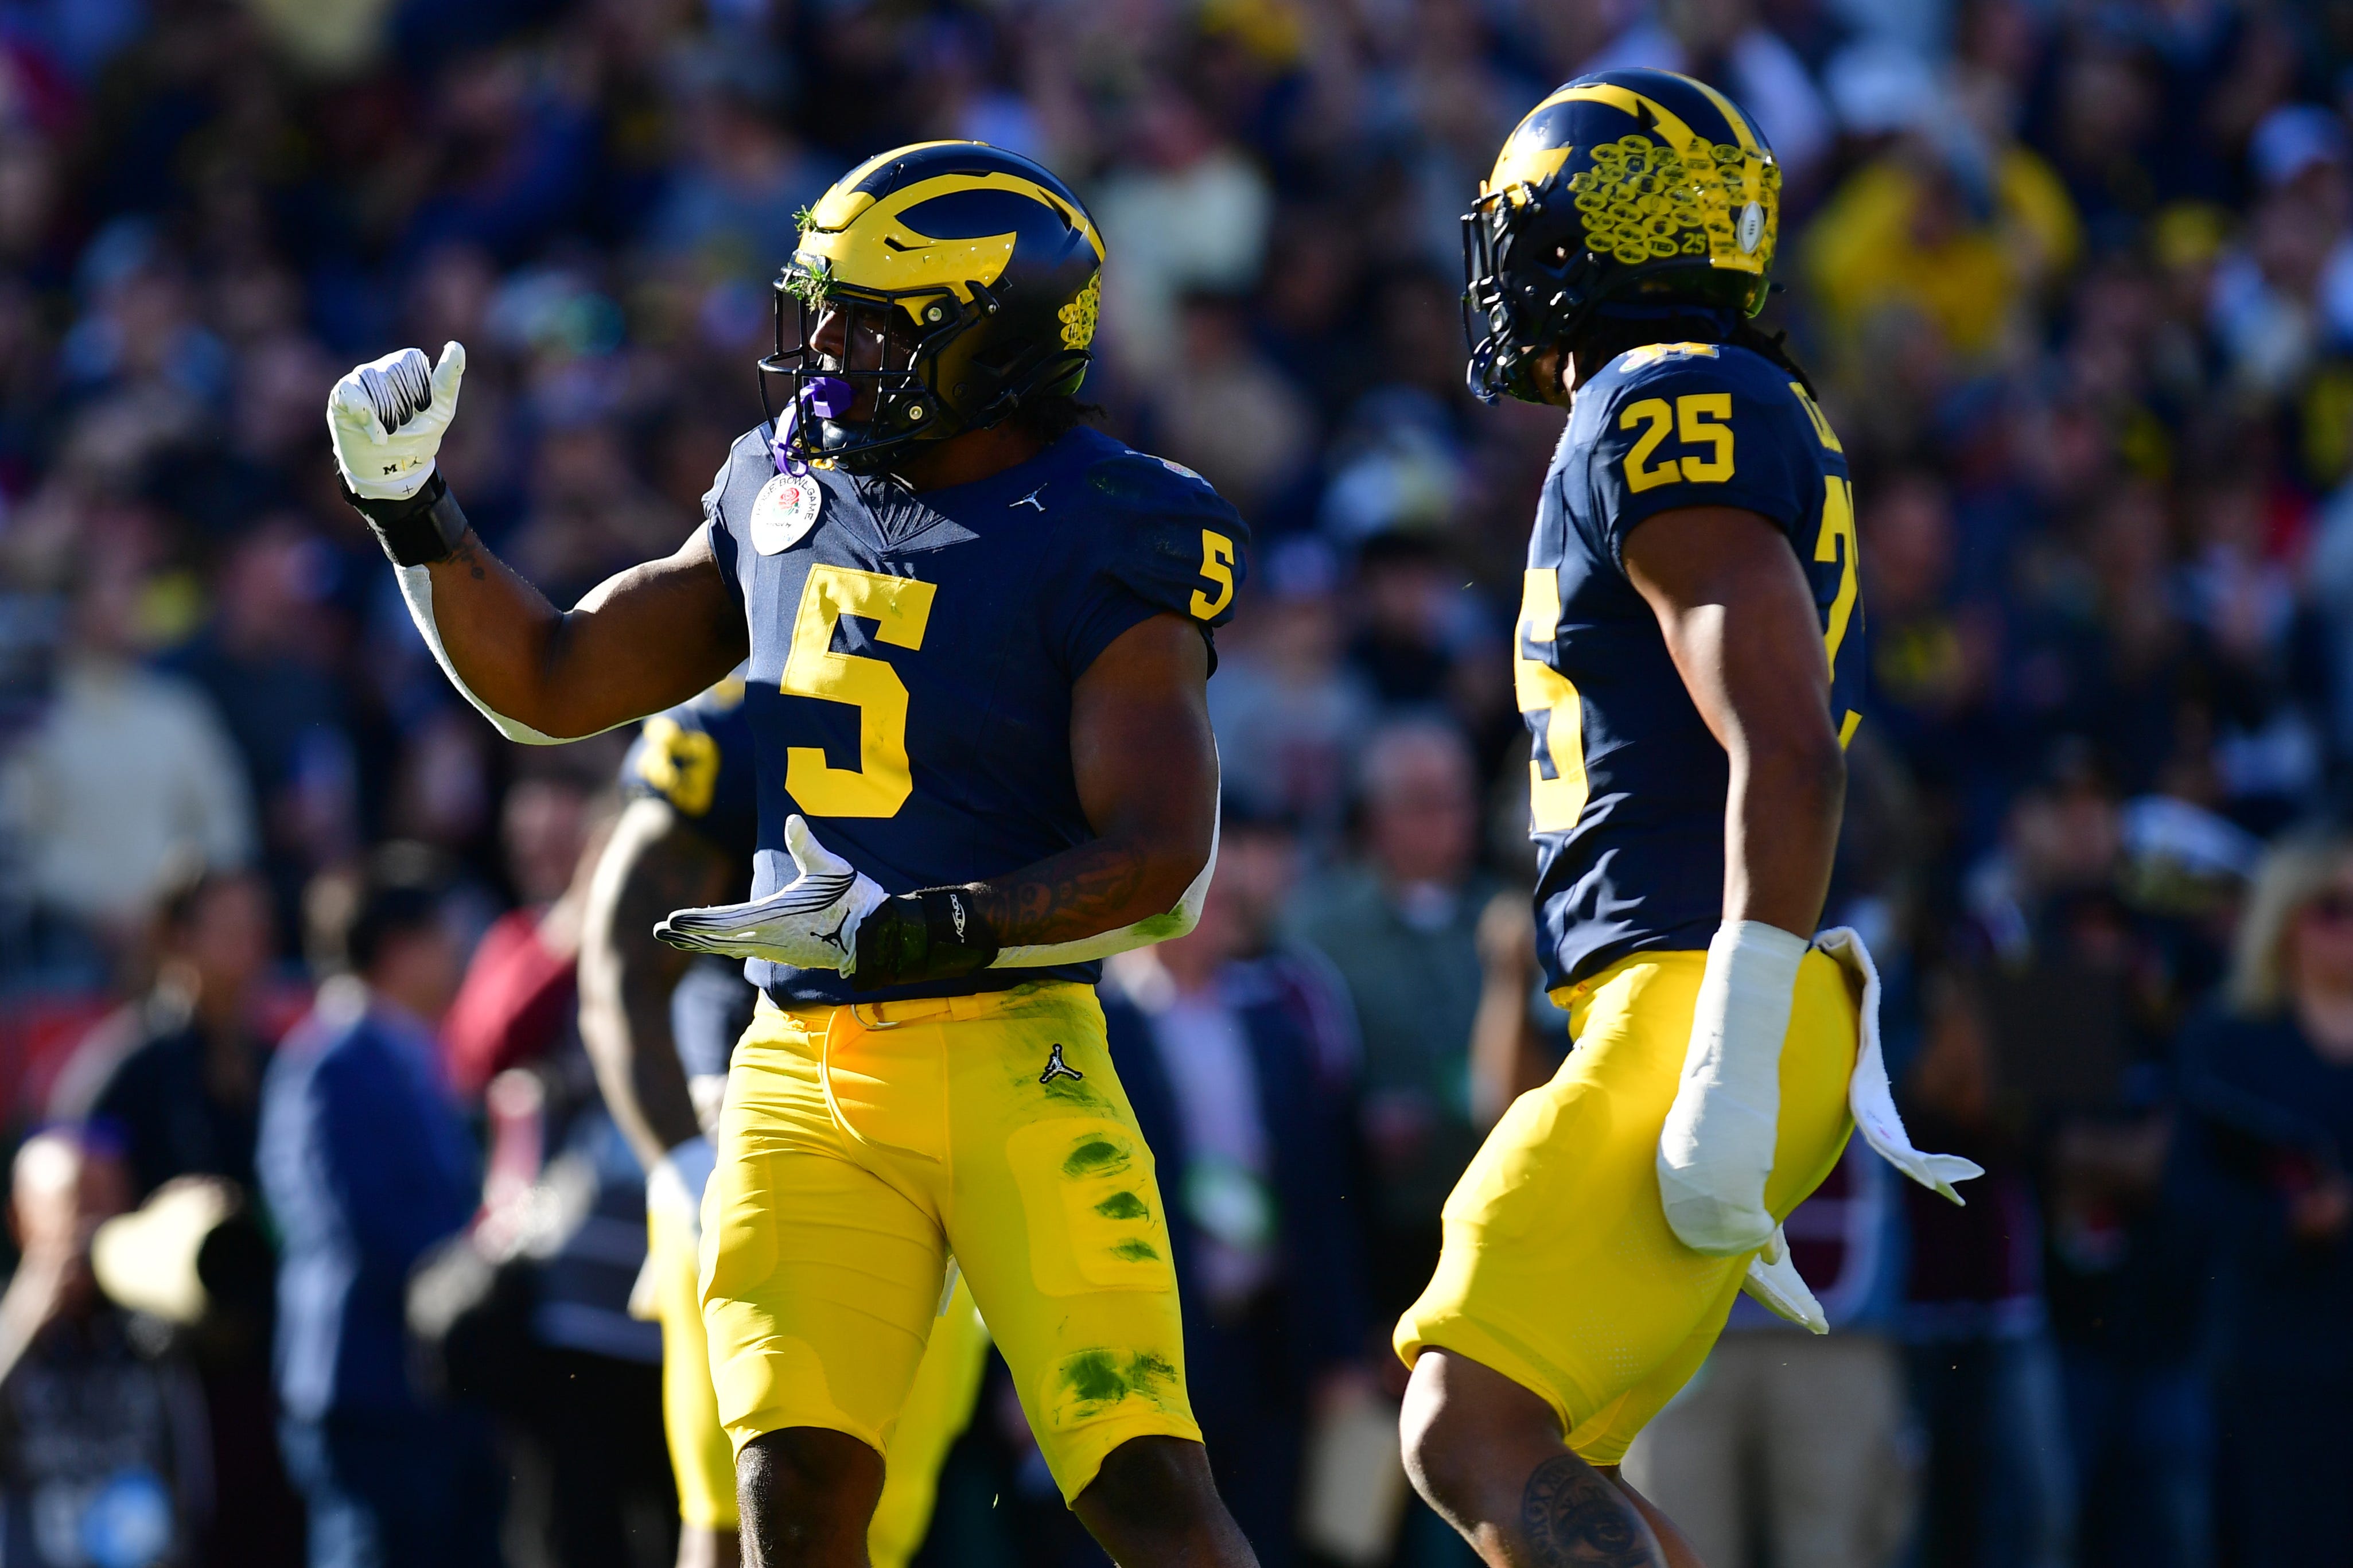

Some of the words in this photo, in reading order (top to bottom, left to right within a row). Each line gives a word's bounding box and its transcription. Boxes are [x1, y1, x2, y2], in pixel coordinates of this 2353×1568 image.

[1682, 232, 1708, 254] 25
[383, 464, 398, 476] M
[1619, 392, 1736, 494] 25
[779, 477, 808, 491] BOWL
[804, 488, 817, 521] GAME
[1190, 528, 1234, 621] 5
[1814, 475, 1865, 752] 2
[780, 563, 938, 818] 5
[950, 893, 965, 939] DONJOY
